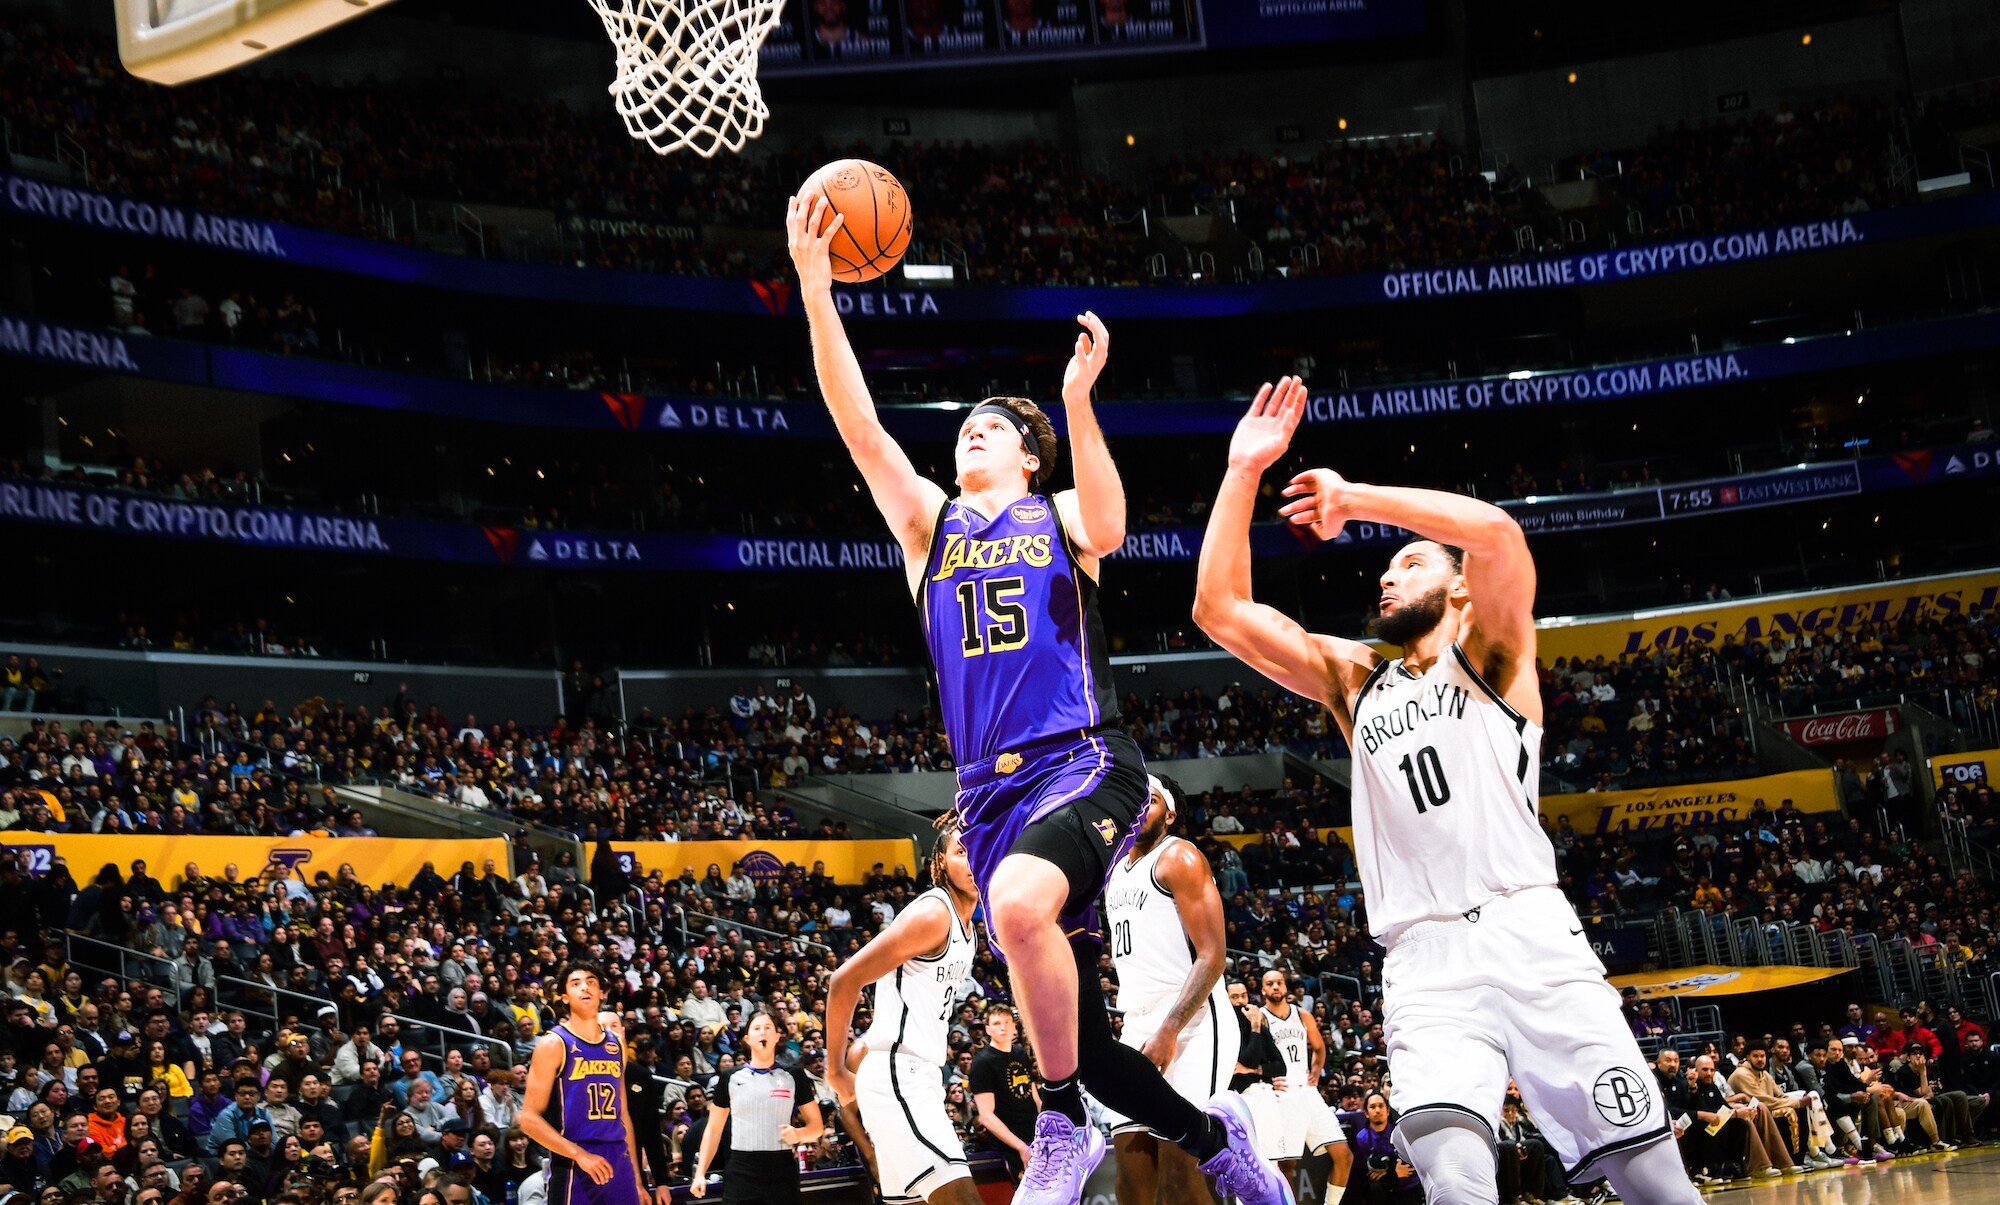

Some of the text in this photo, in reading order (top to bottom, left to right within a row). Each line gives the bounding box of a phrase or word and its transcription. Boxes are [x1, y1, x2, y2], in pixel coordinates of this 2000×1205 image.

[8, 177, 188, 239] CRYPTO.COM
[1382, 217, 1865, 298] OFFICIAL AIRLINE OF CRYPTO.COM ARENA.
[835, 291, 939, 315] DELTA
[1371, 382, 1461, 416] AIRLINE
[1465, 381, 1495, 407] OF
[1501, 364, 1653, 406] CRYPTO.COM
[1657, 353, 1749, 386] ARENA.
[690, 404, 789, 431] DELTA
[1550, 511, 1574, 524] 10th
[1576, 507, 1625, 521] Birthday
[1669, 488, 1713, 511] 7:55
[0, 482, 390, 551] RLINE OF CRYPTO.COM ARENA.
[554, 540, 641, 561] DELTA
[738, 539, 835, 568] OFFICIAL
[931, 533, 1053, 582] LAKERS
[956, 575, 1030, 659] 15
[1624, 620, 1718, 656] LOS
[1729, 587, 1963, 639] ANGELES
[1132, 664, 1147, 674] PR9
[1359, 684, 1469, 756] BROOKLYN
[1801, 713, 1873, 744] Coca-Cola
[1398, 745, 1451, 815] 10
[1625, 792, 1738, 814] LOS ANGELES
[1596, 807, 1739, 839] LAKERS
[1116, 918, 1132, 959] 20
[568, 1056, 622, 1081] LAKERS
[1286, 1044, 1301, 1063] 12
[587, 1082, 617, 1120] 12
